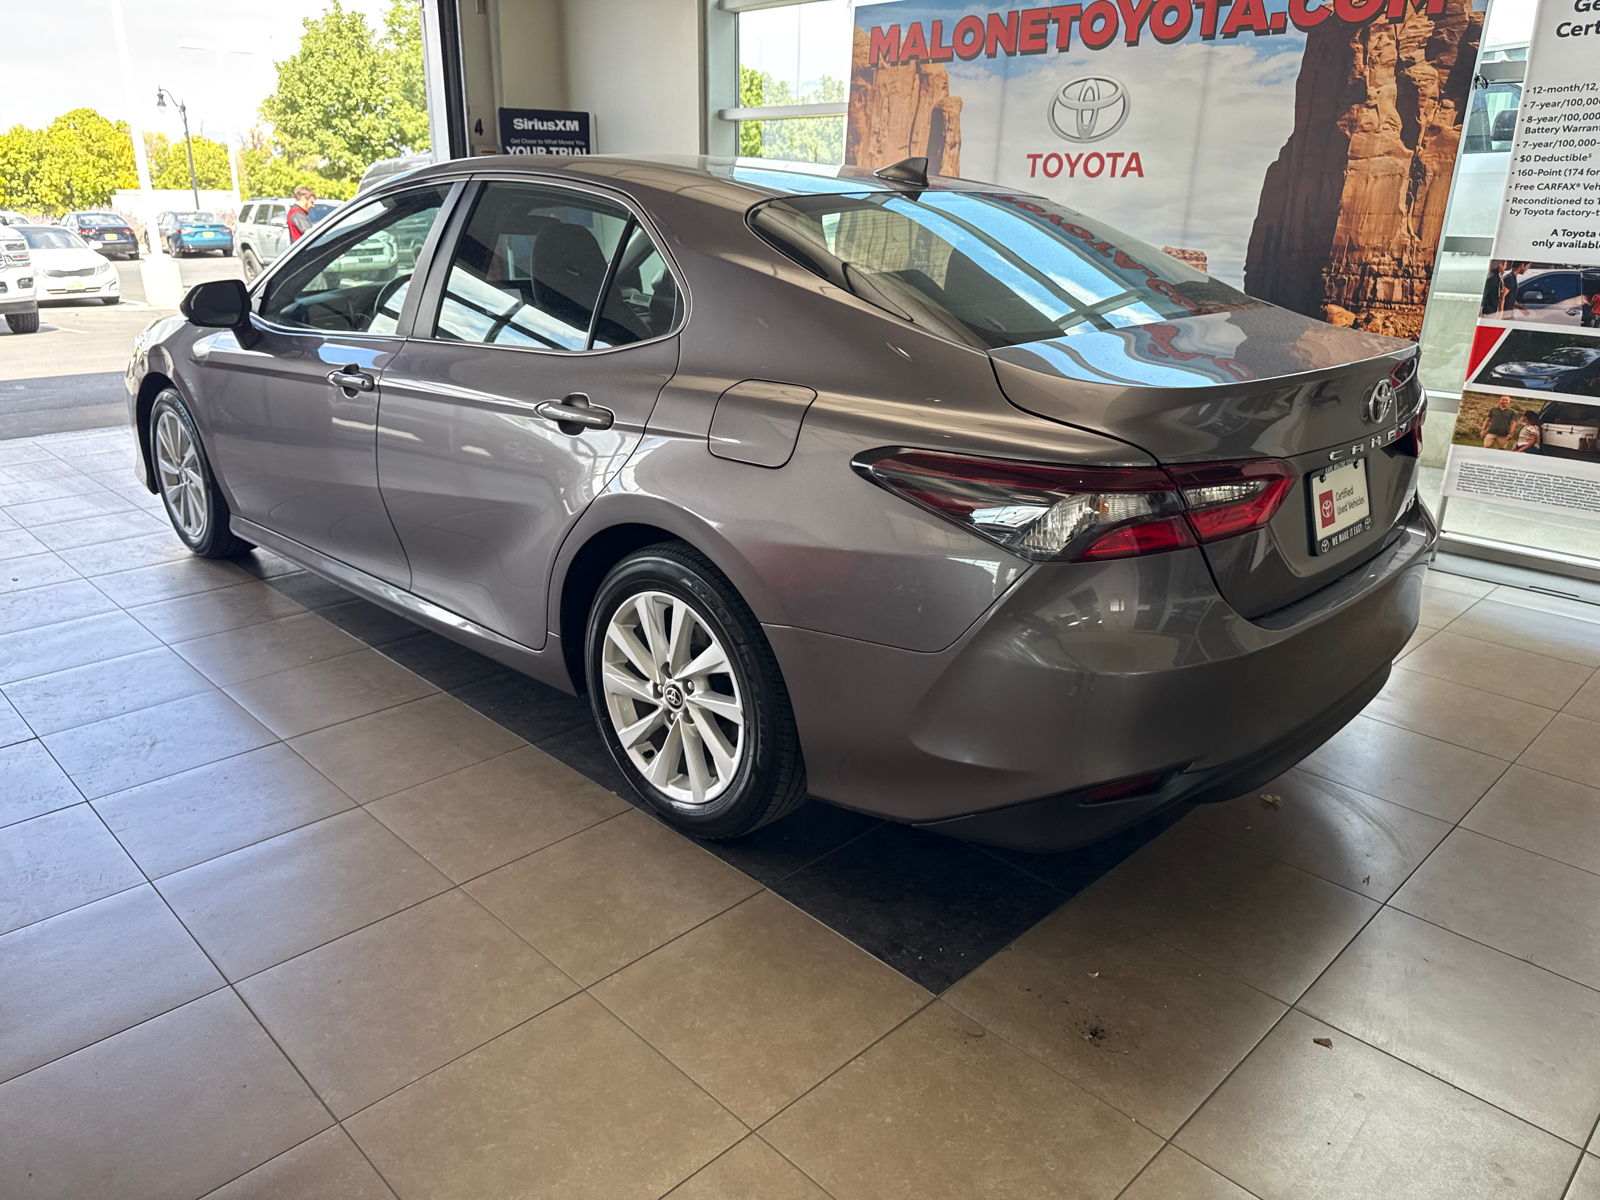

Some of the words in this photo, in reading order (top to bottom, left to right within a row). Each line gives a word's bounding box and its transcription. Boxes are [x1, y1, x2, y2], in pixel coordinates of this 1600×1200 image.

[1556, 20, 1600, 38] Cert
[1530, 97, 1600, 111] 7-year/100,00
[513, 118, 579, 131] SiriusXM
[1524, 126, 1561, 135] Battery
[505, 146, 546, 156] YOUR
[1519, 154, 1532, 163] $0
[1026, 152, 1144, 178] TOYOTA
[1517, 168, 1563, 177] 160-Point
[1563, 168, 1584, 178] (174
[1514, 183, 1535, 191] Free
[1511, 196, 1582, 205] Reconditioned
[1583, 197, 1595, 206] to
[1509, 207, 1522, 217] by
[1523, 207, 1555, 217] Toyota
[1550, 228, 1559, 237] A
[1561, 229, 1597, 239] Toyota
[1531, 239, 1555, 249] only
[1335, 485, 1354, 501] Certified
[1337, 503, 1348, 515] Used
[1346, 496, 1365, 510] Vehicles
